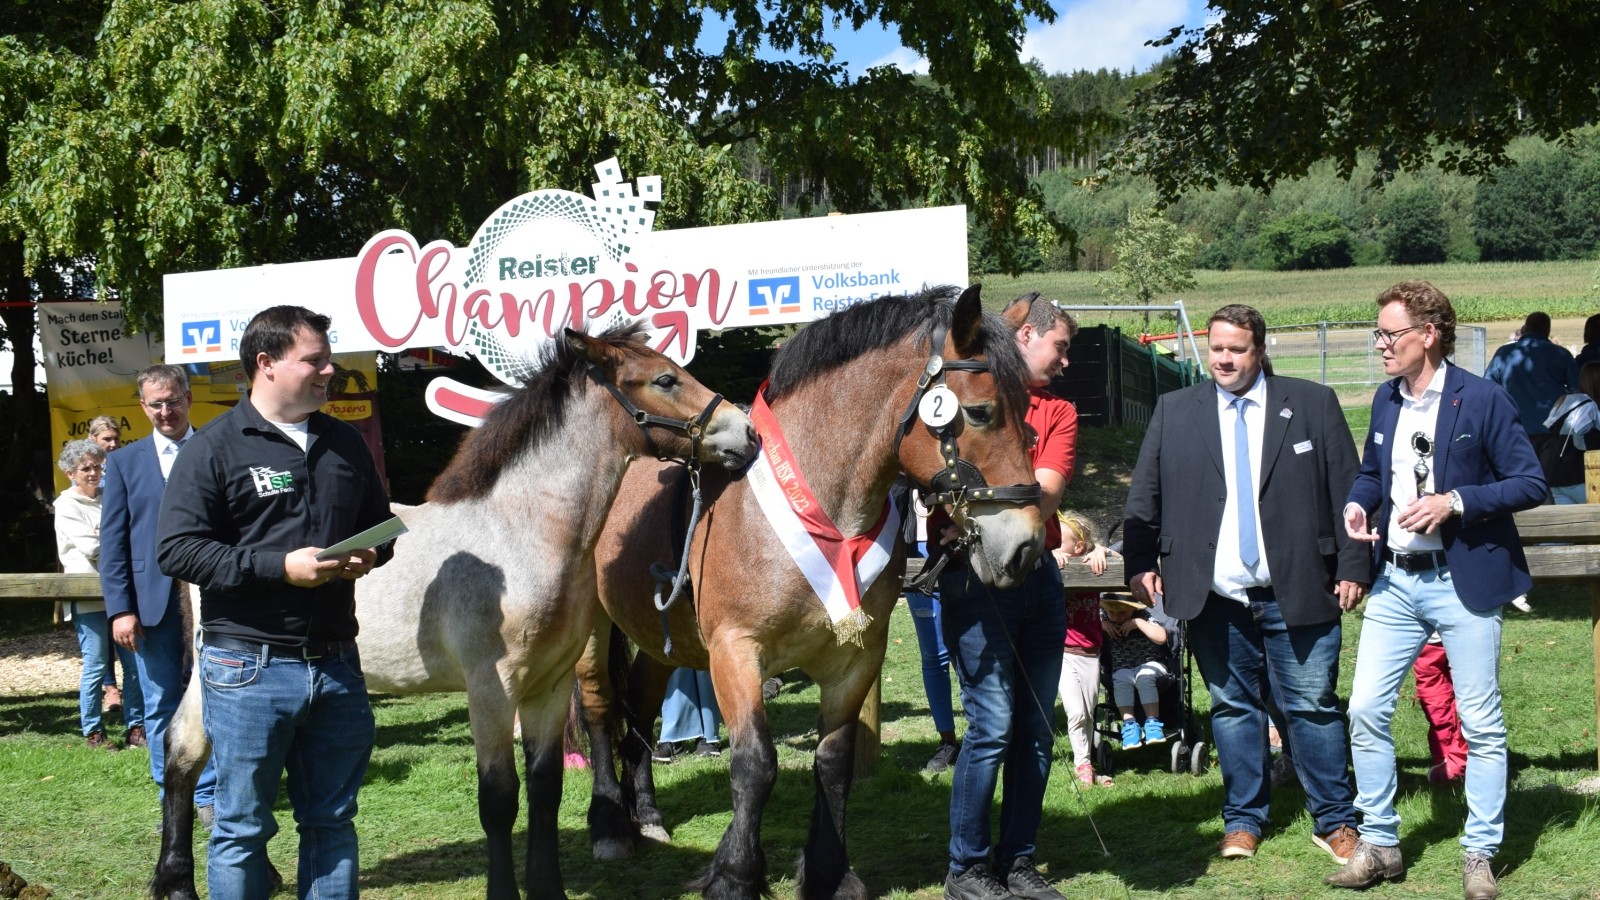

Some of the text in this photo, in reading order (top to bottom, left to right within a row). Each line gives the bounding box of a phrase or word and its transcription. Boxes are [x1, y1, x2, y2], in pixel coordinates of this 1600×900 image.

[498, 252, 600, 281] Reister
[760, 265, 801, 275] freundlicher
[801, 261, 850, 273] Unterstützung
[850, 261, 863, 269] der
[811, 268, 901, 290] Volksbank
[355, 235, 738, 348] Champion
[47, 313, 76, 325] Mach
[79, 311, 99, 323] den
[57, 347, 114, 369] küche!
[325, 403, 366, 415] Josera
[933, 394, 943, 418] 2
[252, 473, 293, 493] HSF
[775, 460, 796, 486] HSK
[786, 481, 810, 513] 2023
